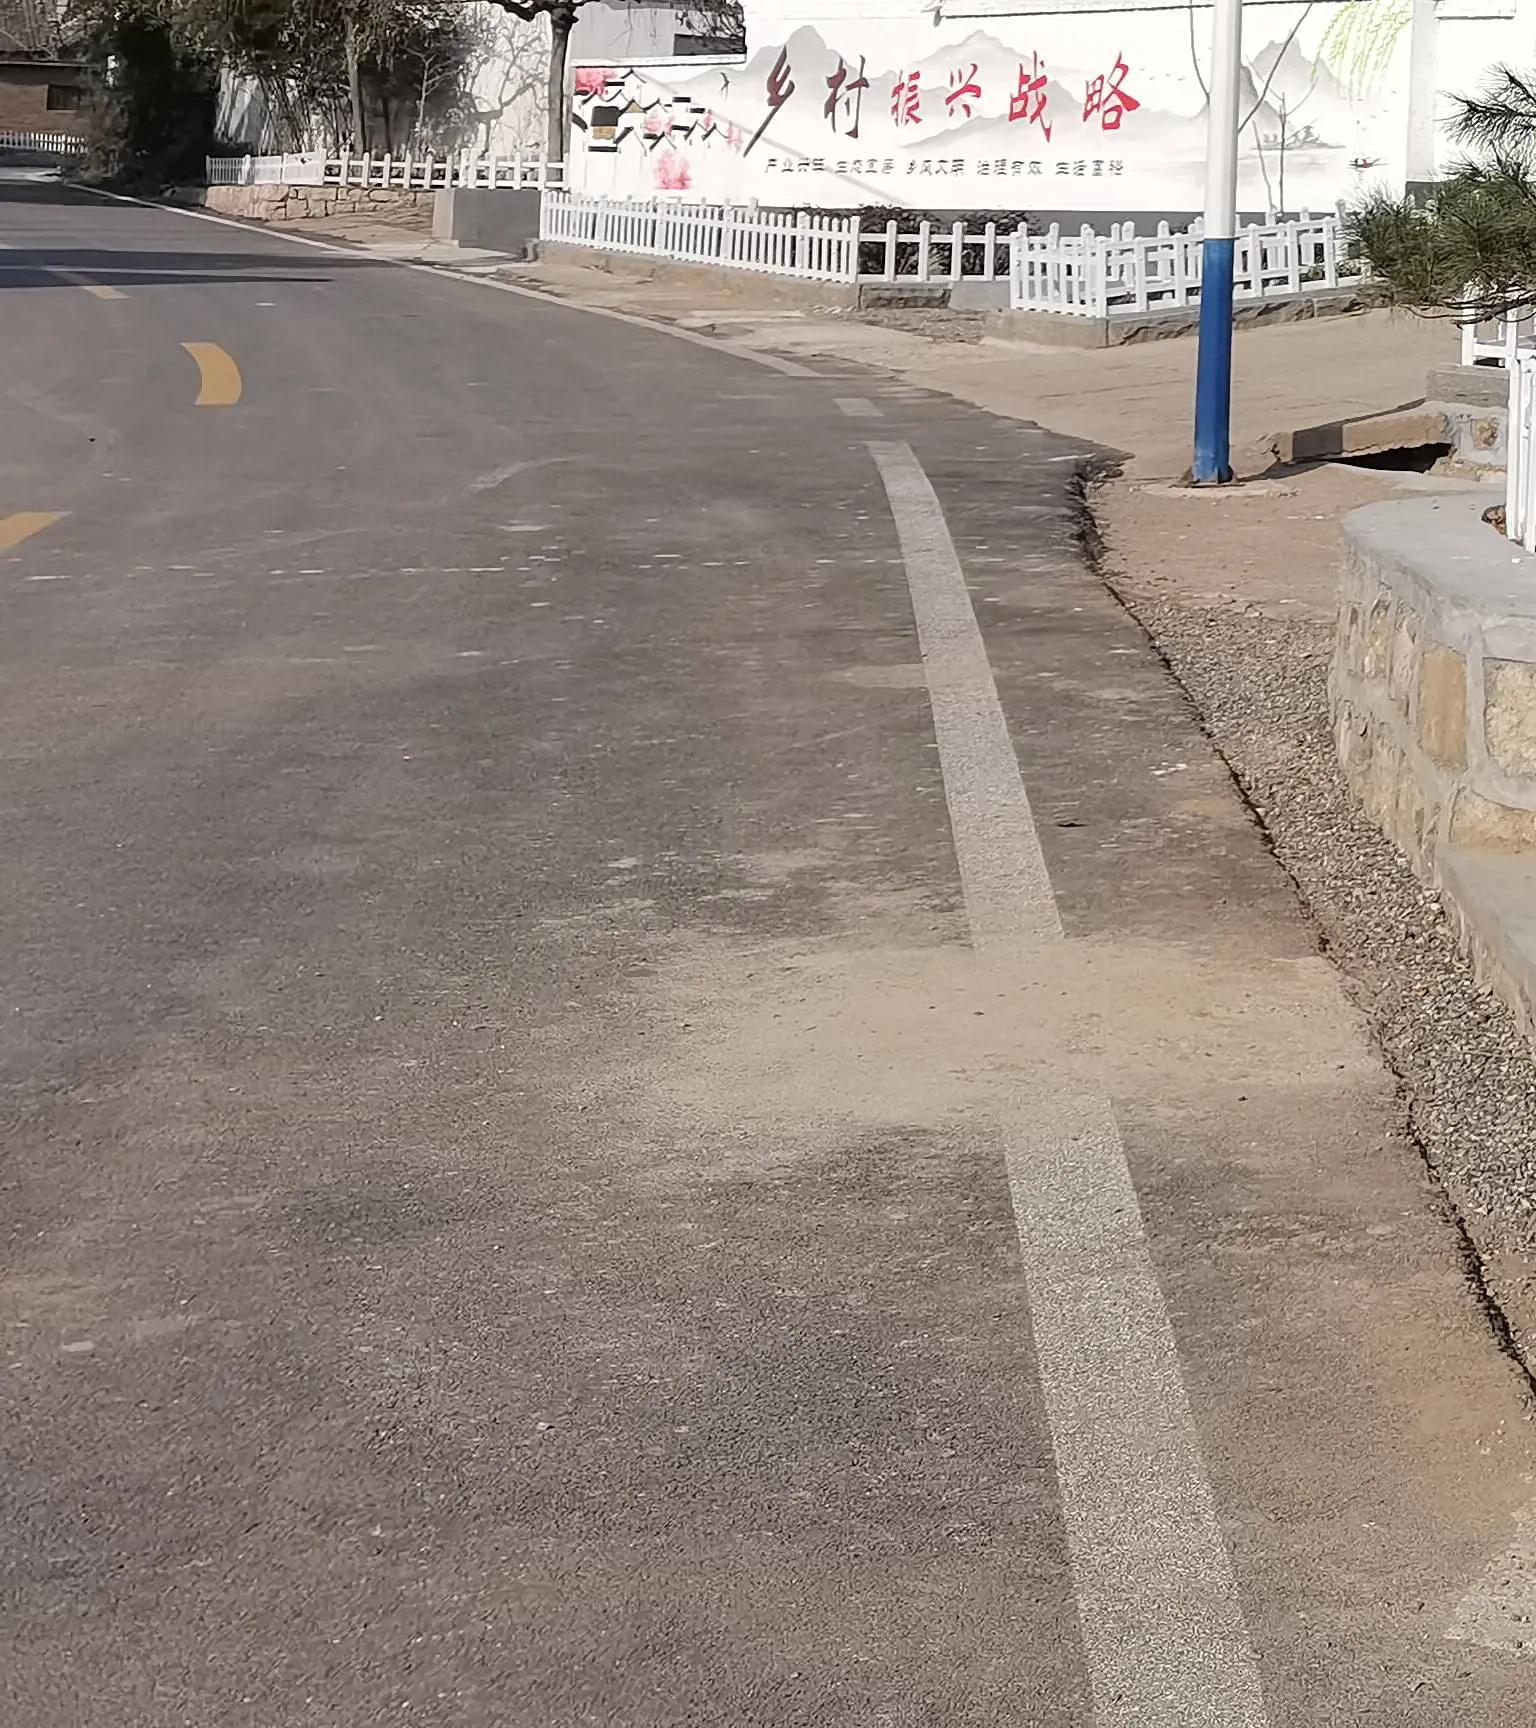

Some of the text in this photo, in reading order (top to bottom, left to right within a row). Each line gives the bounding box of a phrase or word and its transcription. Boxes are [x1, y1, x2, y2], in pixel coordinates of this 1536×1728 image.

[743, 45, 1141, 158] 乡村振兴战略
